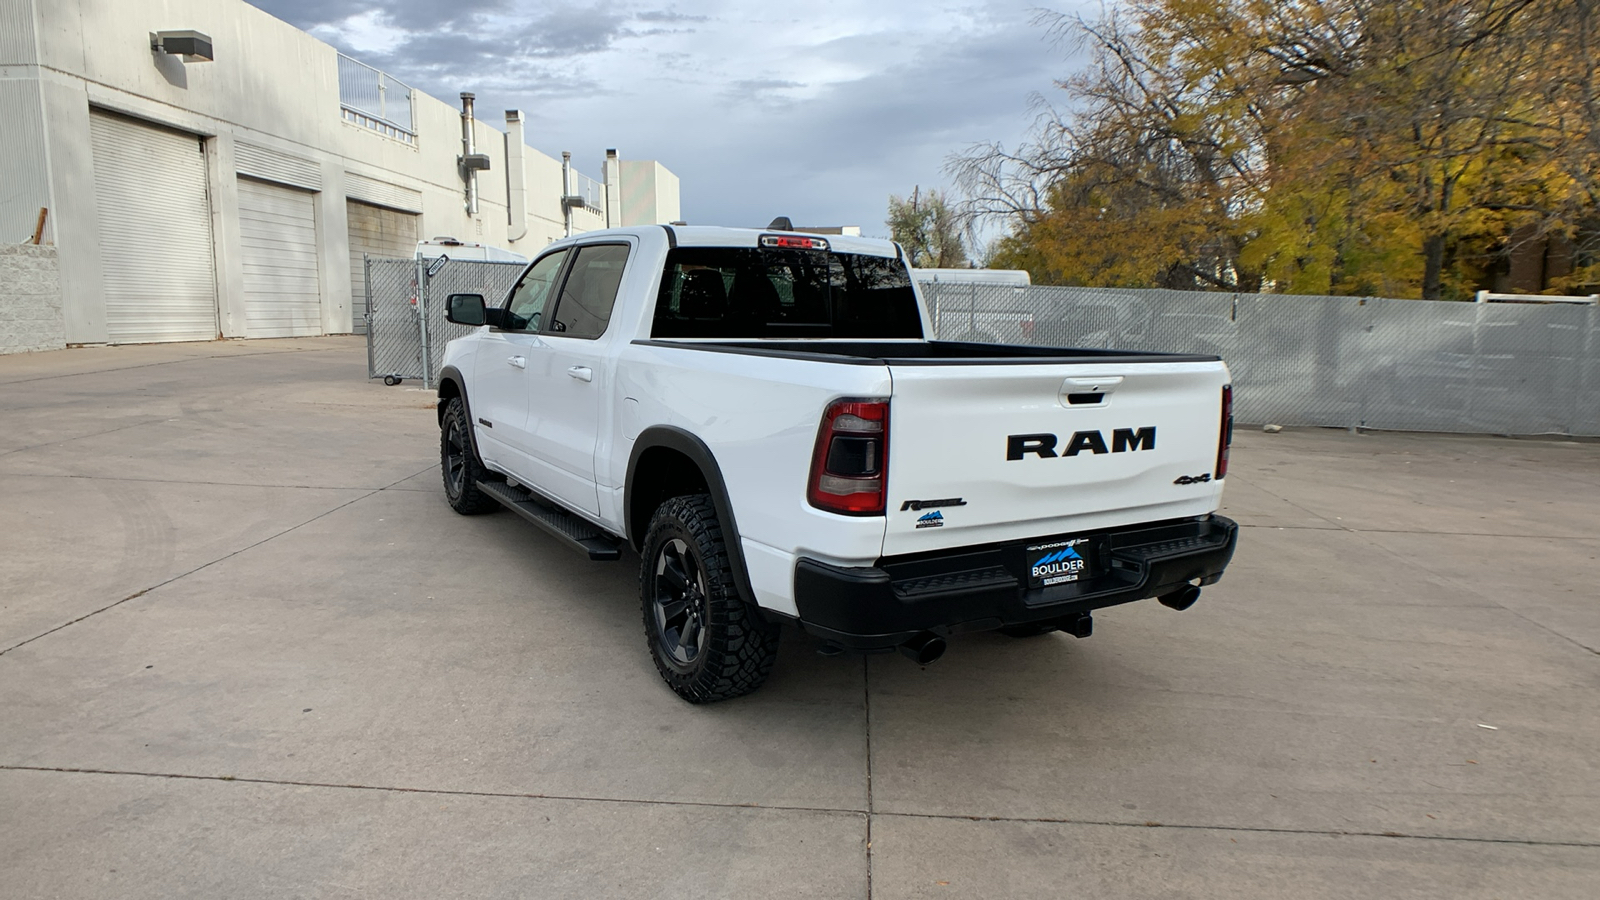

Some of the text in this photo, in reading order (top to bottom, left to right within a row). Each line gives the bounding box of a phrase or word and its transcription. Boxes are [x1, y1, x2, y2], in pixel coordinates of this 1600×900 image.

[1006, 425, 1157, 461] RAM
[900, 497, 968, 511] REBEL
[1032, 559, 1085, 577] BOULDER
